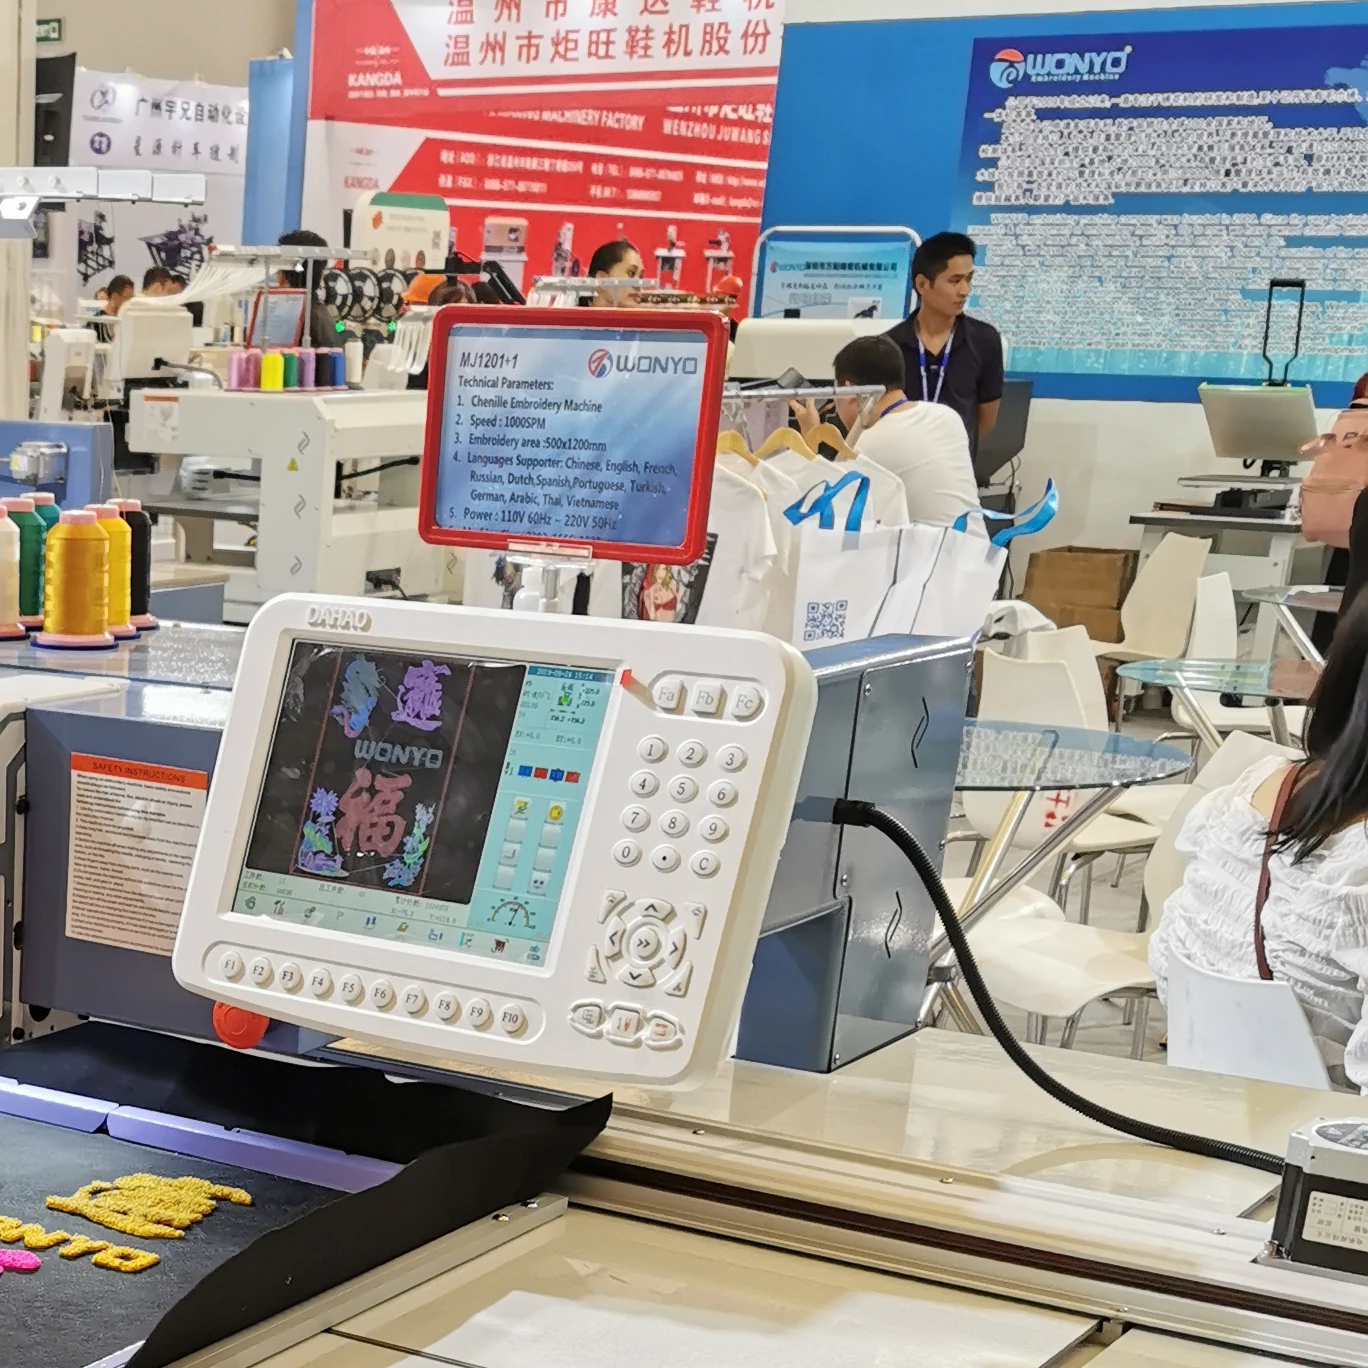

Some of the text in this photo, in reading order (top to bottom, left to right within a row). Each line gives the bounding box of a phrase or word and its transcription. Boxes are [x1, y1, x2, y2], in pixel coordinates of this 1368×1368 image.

[443, 19, 772, 67] 温州市炬旺鞋机股份
[1026, 51, 1128, 75] WONYO
[348, 71, 402, 87] KANGDA
[601, 109, 645, 132] FACTORY
[663, 118, 716, 140] WENZHOU
[460, 352, 519, 369] MJ1201+1
[616, 355, 698, 375] WONYO
[458, 375, 554, 391] Technical Parameters:
[457, 395, 603, 413] 1. Chenille Embroidery Machine
[455, 415, 463, 426] 2.
[470, 415, 497, 430] Speed
[504, 417, 546, 430] 1000SPM
[454, 434, 462, 445] 3.
[469, 434, 519, 449] Embroidery
[522, 439, 541, 449] area
[453, 452, 677, 477] 4. Languages Supporter: Chinese, English, French,
[470, 471, 504, 485] Russian,
[630, 479, 666, 495] Turkish,
[471, 490, 619, 510] German, Arabic, Thai, Vietnamese
[464, 508, 492, 521] Power
[501, 510, 525, 523] 110V
[528, 512, 552, 526] 60Hz
[565, 513, 589, 529] 220V
[592, 515, 617, 530] 50Hz
[306, 604, 372, 632] DAHAO
[658, 687, 674, 701] Fa
[696, 690, 713, 705] Fb
[736, 694, 753, 709] Fc
[354, 739, 443, 769] WONYO
[647, 744, 653, 756] 1
[686, 747, 694, 760] 2
[726, 752, 734, 766] 3
[93, 762, 185, 783] SAFETY INSTRUCTIONS
[639, 778, 646, 790] 4
[677, 782, 686, 795] 5
[717, 788, 725, 800] 6
[631, 811, 639, 824] 7
[668, 817, 677, 829] 8
[709, 822, 717, 835] 9
[622, 846, 630, 859] 0
[699, 857, 709, 870] C
[225, 959, 235, 970] F1
[253, 965, 264, 976] F2
[282, 970, 293, 981] F3
[312, 975, 323, 987] F4
[343, 981, 354, 993] F5
[374, 987, 386, 999] F6
[405, 993, 417, 1005] F7
[438, 999, 450, 1011] F8
[470, 1006, 482, 1018] F9
[502, 1011, 518, 1023] F10
